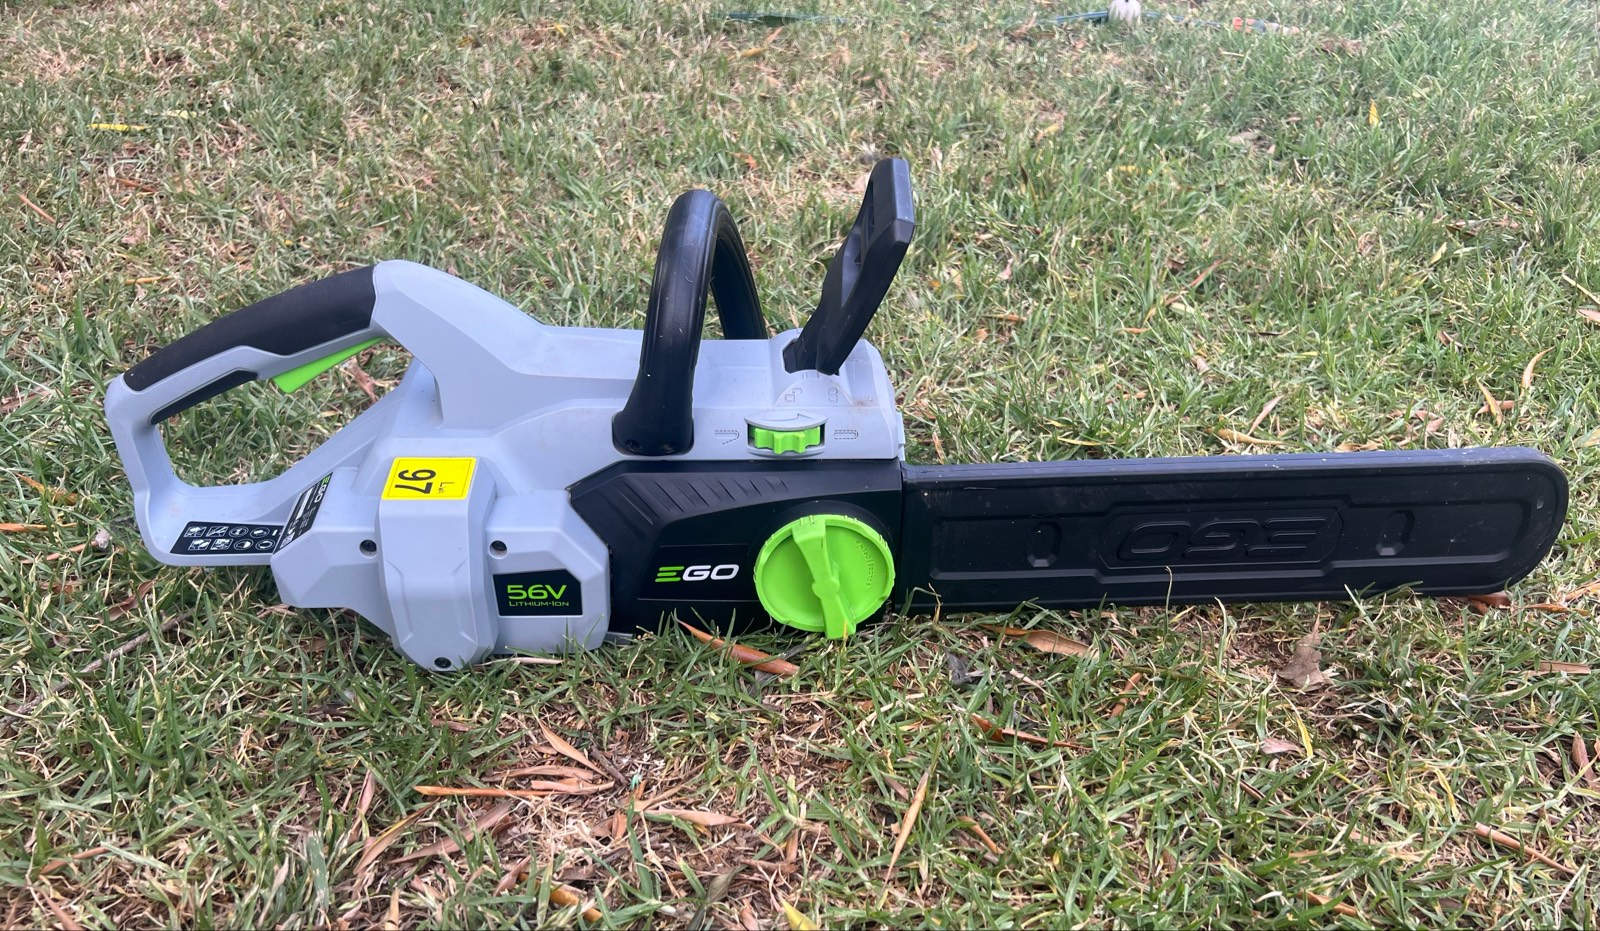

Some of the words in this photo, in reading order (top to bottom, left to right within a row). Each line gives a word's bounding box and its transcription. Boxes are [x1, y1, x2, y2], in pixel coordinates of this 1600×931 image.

[394, 469, 436, 494] 97
[655, 564, 739, 583] EGO
[507, 584, 568, 600] 56V
